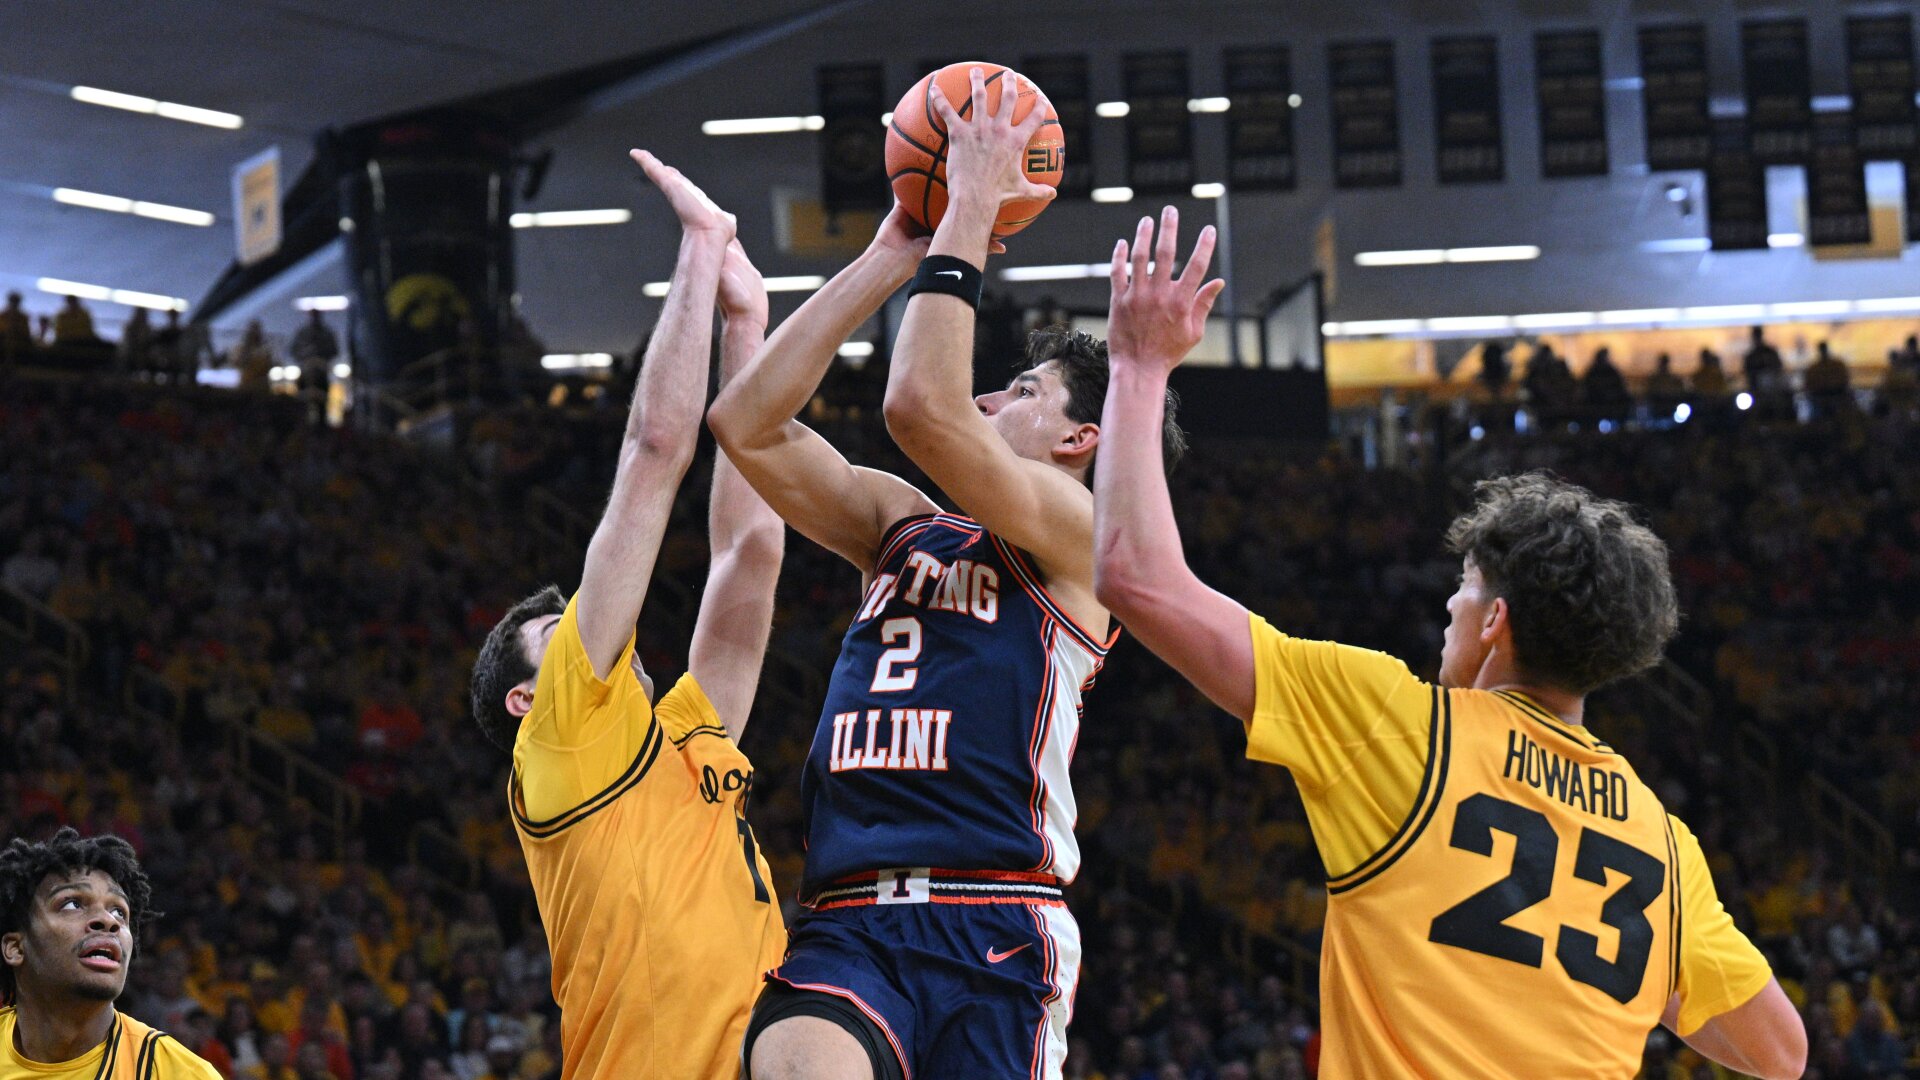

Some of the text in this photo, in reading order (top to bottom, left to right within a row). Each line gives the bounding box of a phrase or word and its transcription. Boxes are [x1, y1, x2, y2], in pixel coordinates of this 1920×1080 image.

[869, 616, 922, 693] 2
[829, 708, 952, 774] ILLINI
[1503, 729, 1629, 822] HOWARD
[892, 870, 912, 898] I
[1427, 791, 1666, 1006] 23
